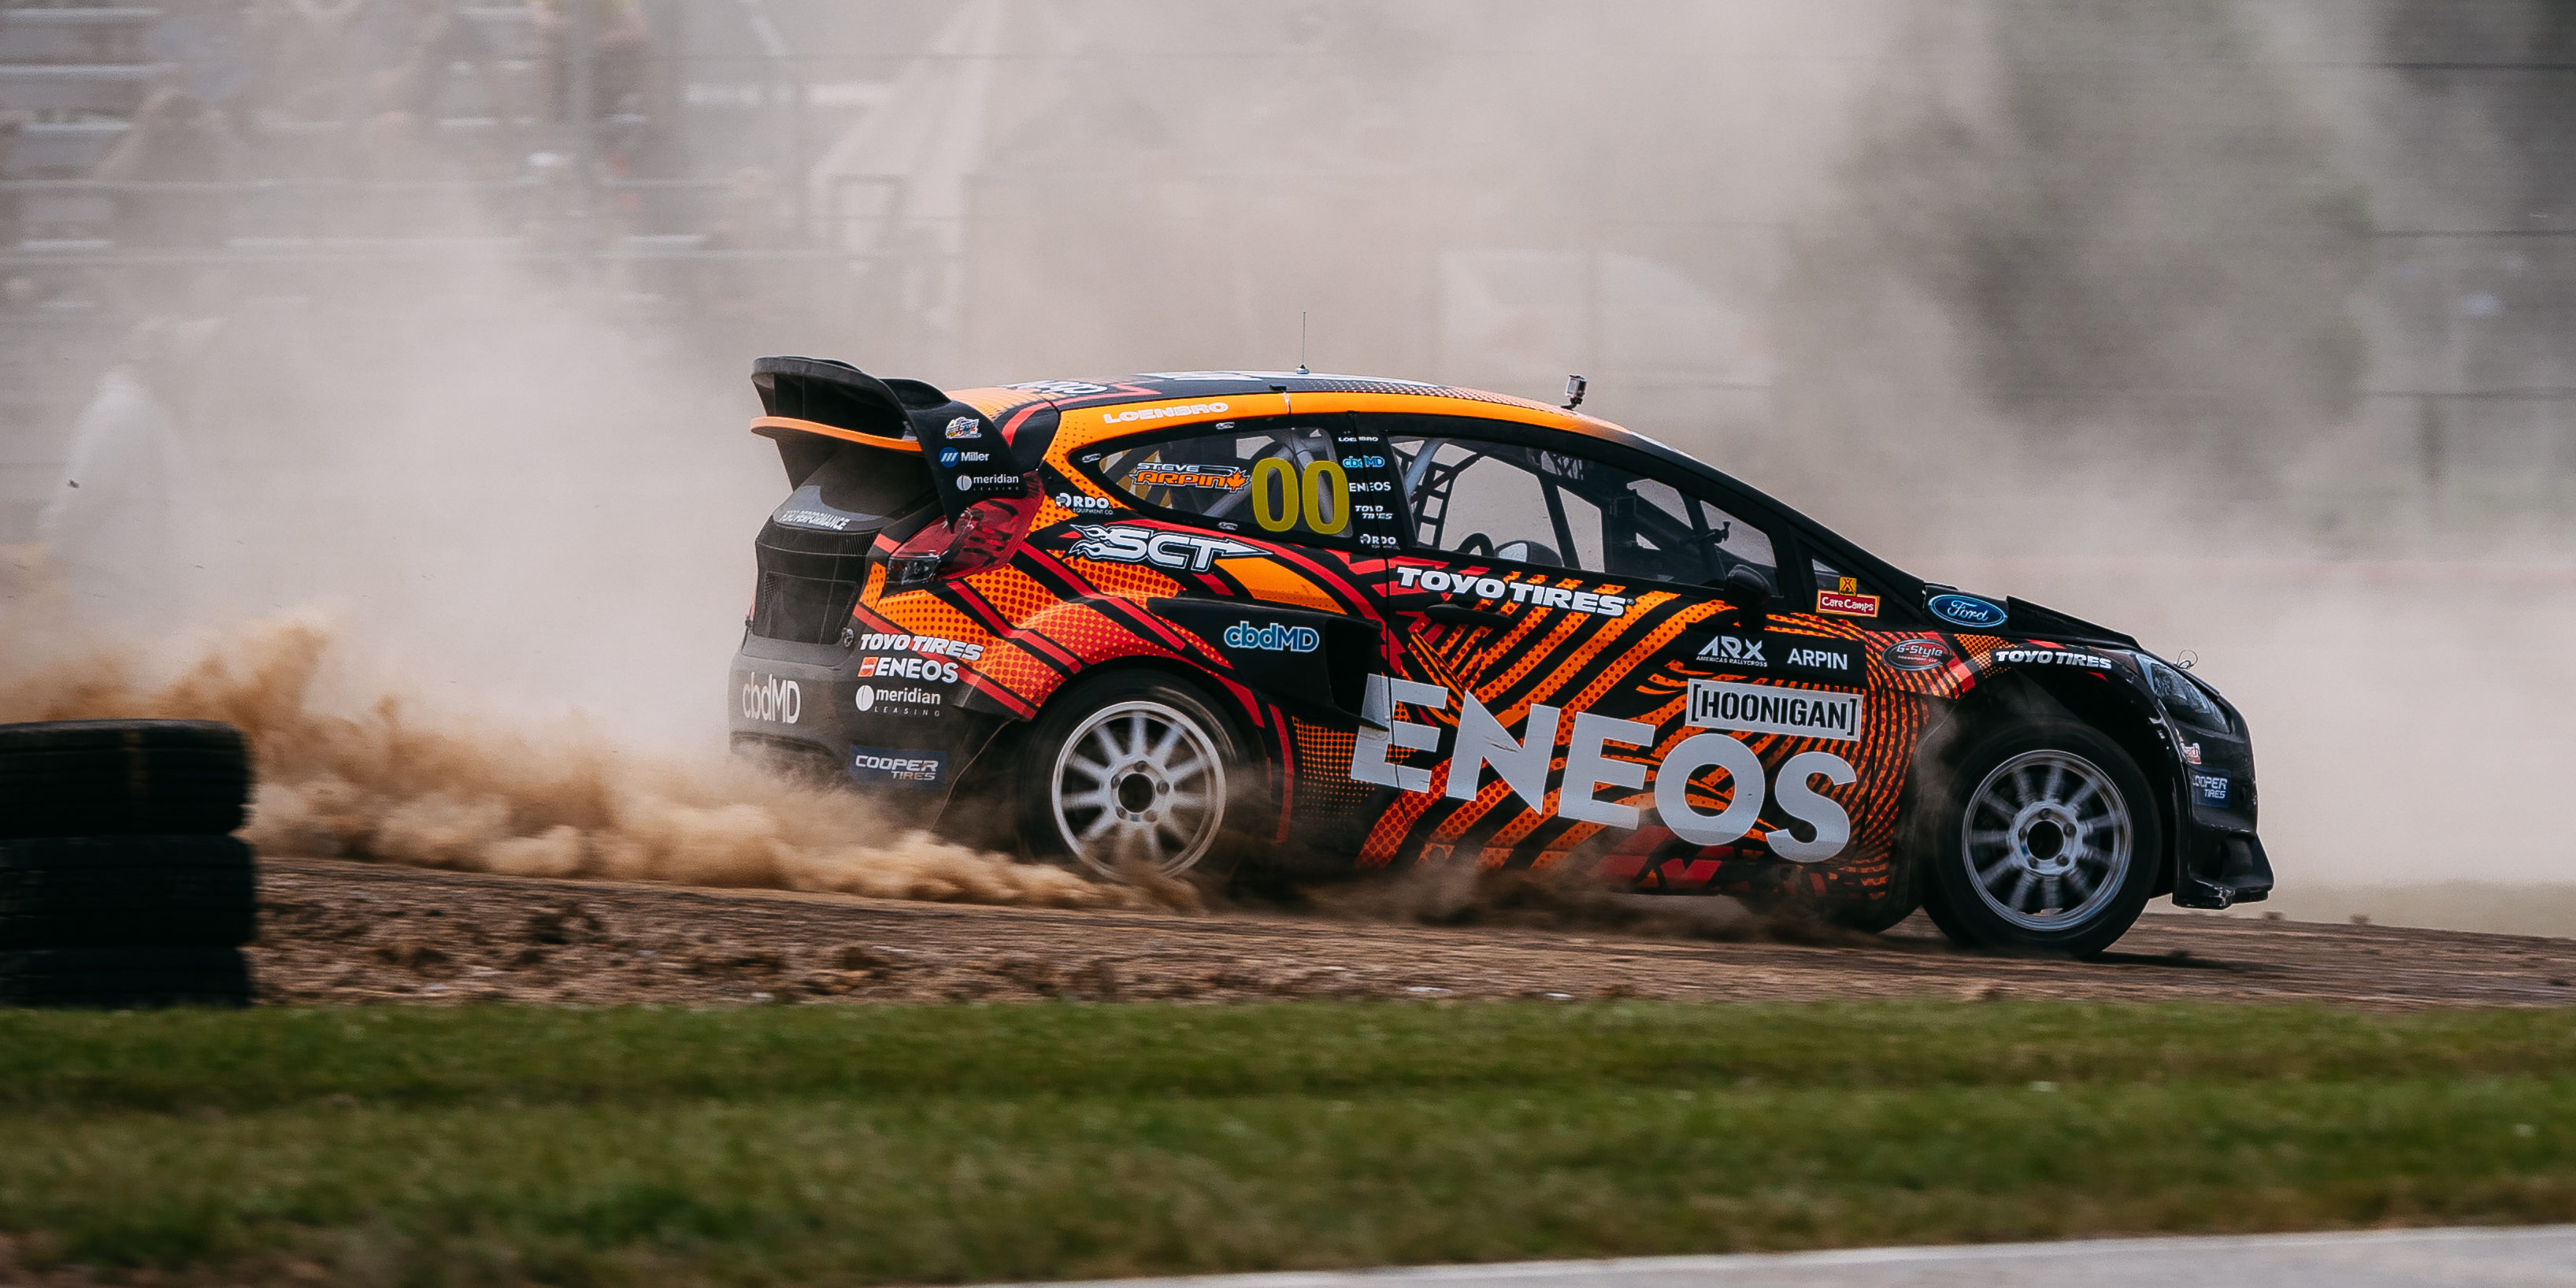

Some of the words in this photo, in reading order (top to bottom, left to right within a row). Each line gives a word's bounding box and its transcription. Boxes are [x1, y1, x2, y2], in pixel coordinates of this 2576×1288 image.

[1103, 402, 1229, 424] LOENBRO
[961, 452, 989, 461] Miller
[1136, 462, 1199, 472] STEVE
[973, 474, 1019, 483] meridian
[1349, 481, 1392, 492] ENEOS
[1073, 496, 1109, 508] RDO
[1251, 458, 1350, 534] 00
[1087, 525, 1230, 572] SCT
[1397, 566, 1506, 599] TOYO
[1509, 581, 1628, 616] TIRES
[1822, 596, 1844, 608] Care
[1844, 599, 1874, 612] Camps
[1947, 599, 1989, 622] Ford
[1224, 620, 1320, 652] cbdMD
[860, 633, 911, 651] TOYO
[911, 635, 984, 661] TIRES
[1697, 636, 1766, 661] ARX
[1896, 644, 1944, 657] G-Style
[1729, 659, 1768, 667] RALLYCROSS
[1787, 648, 1848, 670] ARPIN
[1996, 650, 2055, 664] TOYO
[2055, 651, 2112, 670] TIRES
[875, 657, 959, 684] ENEOS
[743, 671, 801, 724] cbdMD
[876, 688, 941, 705] meridian
[874, 706, 940, 717] LEASING
[1691, 683, 1858, 737] [HOONIGAN]
[855, 755, 939, 772] COOPER
[1351, 673, 1857, 863] ENEOS
[891, 771, 936, 781] TIRES
[2204, 789, 2226, 799] TIRES
